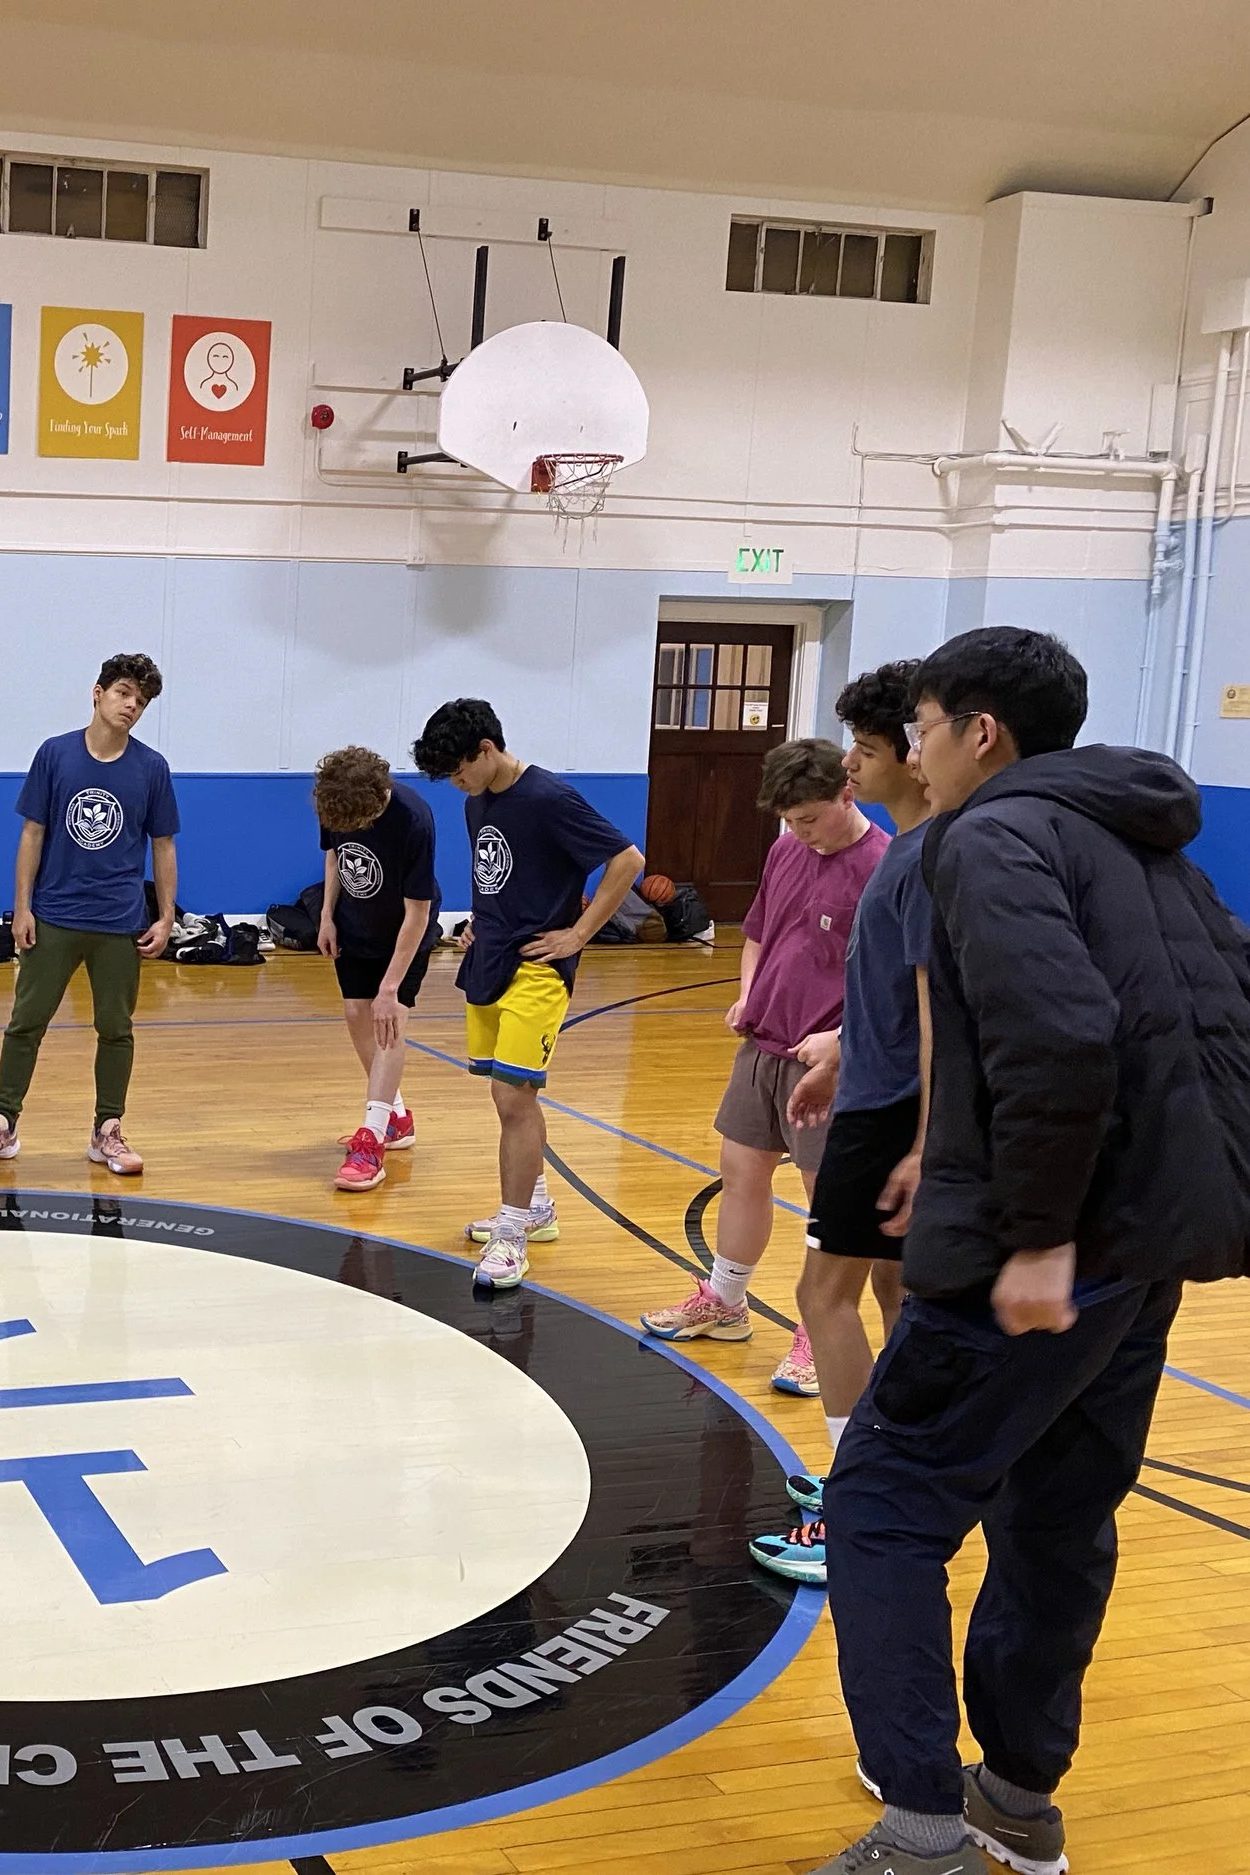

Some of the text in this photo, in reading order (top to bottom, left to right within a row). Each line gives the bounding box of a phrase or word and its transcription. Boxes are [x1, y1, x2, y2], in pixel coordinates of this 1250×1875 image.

[83, 420, 103, 435] Your
[105, 421, 129, 440] Spark
[180, 425, 254, 445] Self-Management
[736, 547, 784, 573] EXIT
[422, 1591, 671, 1725] FRIENDS
[314, 1705, 423, 1760] OF
[102, 1729, 302, 1783] THE
